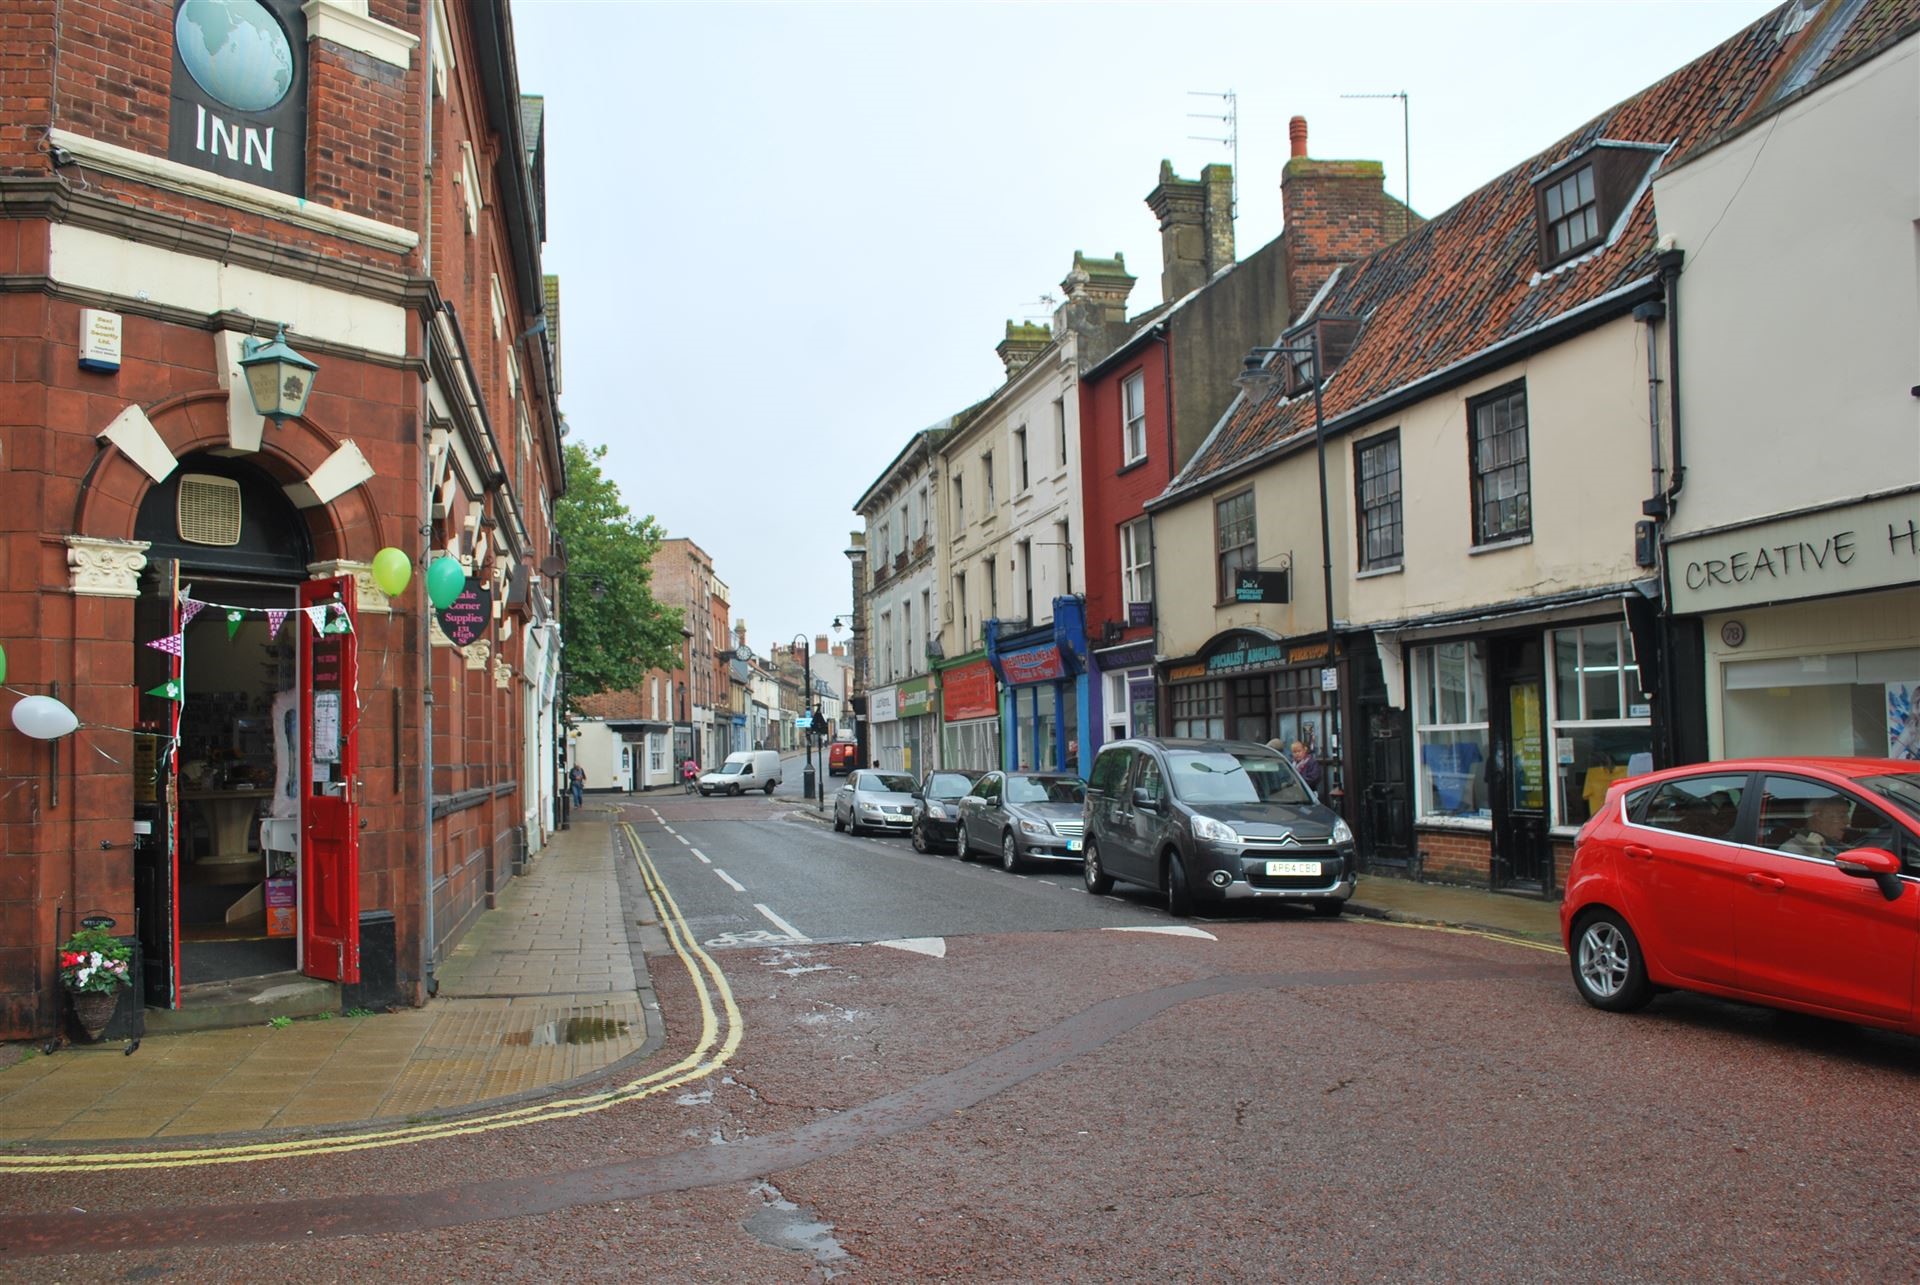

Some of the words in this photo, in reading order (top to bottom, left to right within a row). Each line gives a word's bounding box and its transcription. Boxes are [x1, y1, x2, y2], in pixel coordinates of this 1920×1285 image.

[196, 103, 275, 172] INN
[90, 329, 119, 341] Security
[1686, 530, 1856, 591] CREATIVE
[1888, 519, 1920, 556] H
[456, 590, 477, 600] ake
[445, 612, 484, 625] Supplies
[452, 631, 475, 640] High
[1209, 649, 1245, 669] SPECIALIST
[1247, 644, 1282, 664] ANGLING
